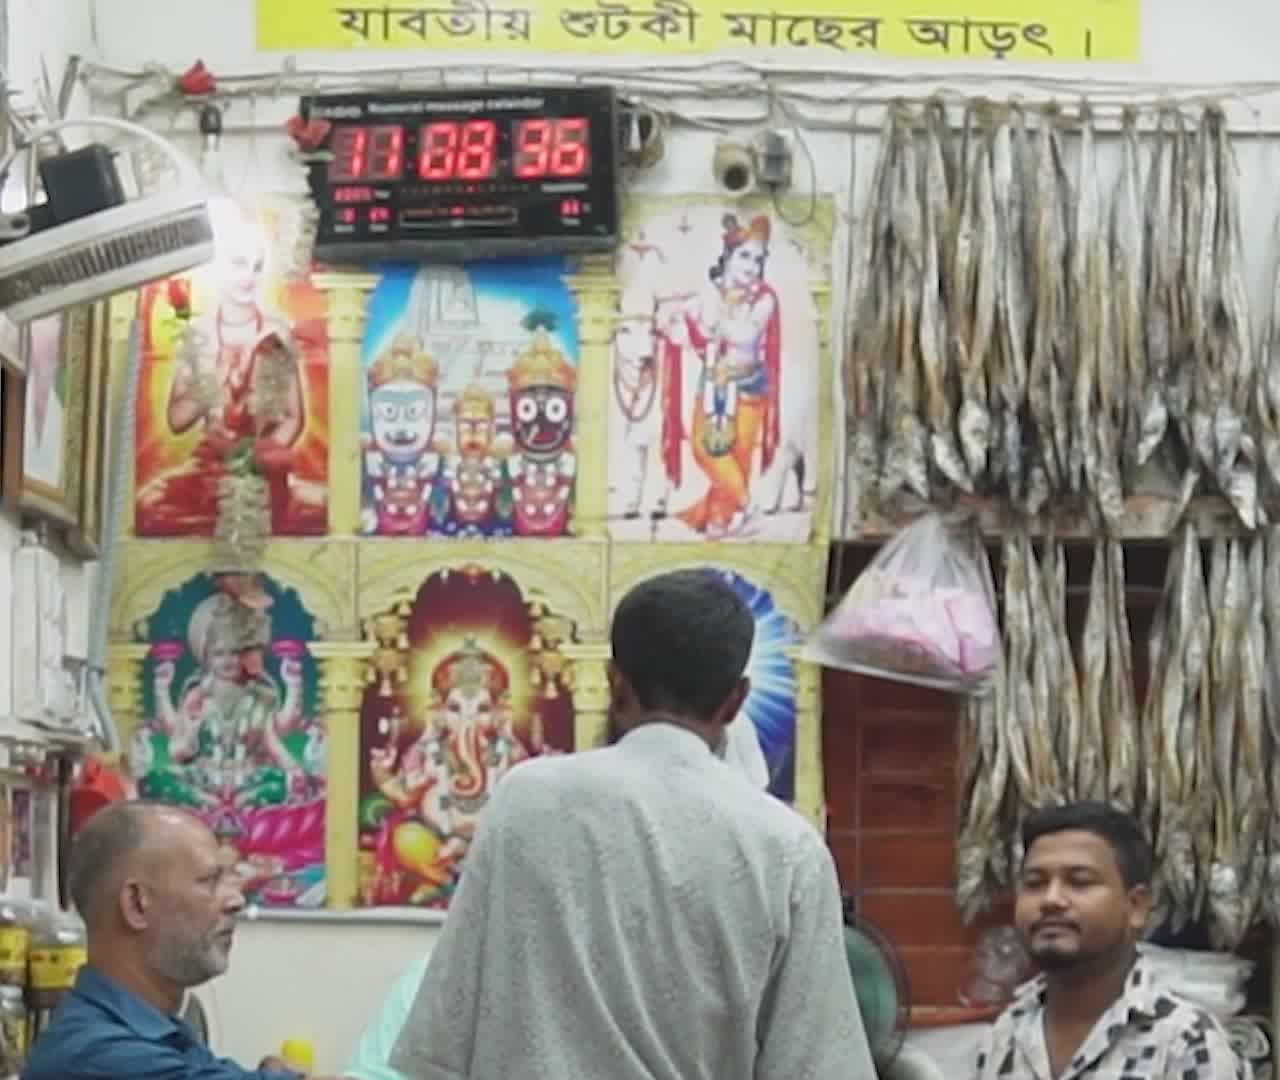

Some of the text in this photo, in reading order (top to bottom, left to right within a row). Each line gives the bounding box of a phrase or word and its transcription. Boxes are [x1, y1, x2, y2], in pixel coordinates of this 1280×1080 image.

[339, 0, 531, 42] যাবতীয়
[560, 0, 697, 42] শুটকী
[722, 11, 883, 51] মাছের
[904, 17, 1054, 59] আড়ৎ
